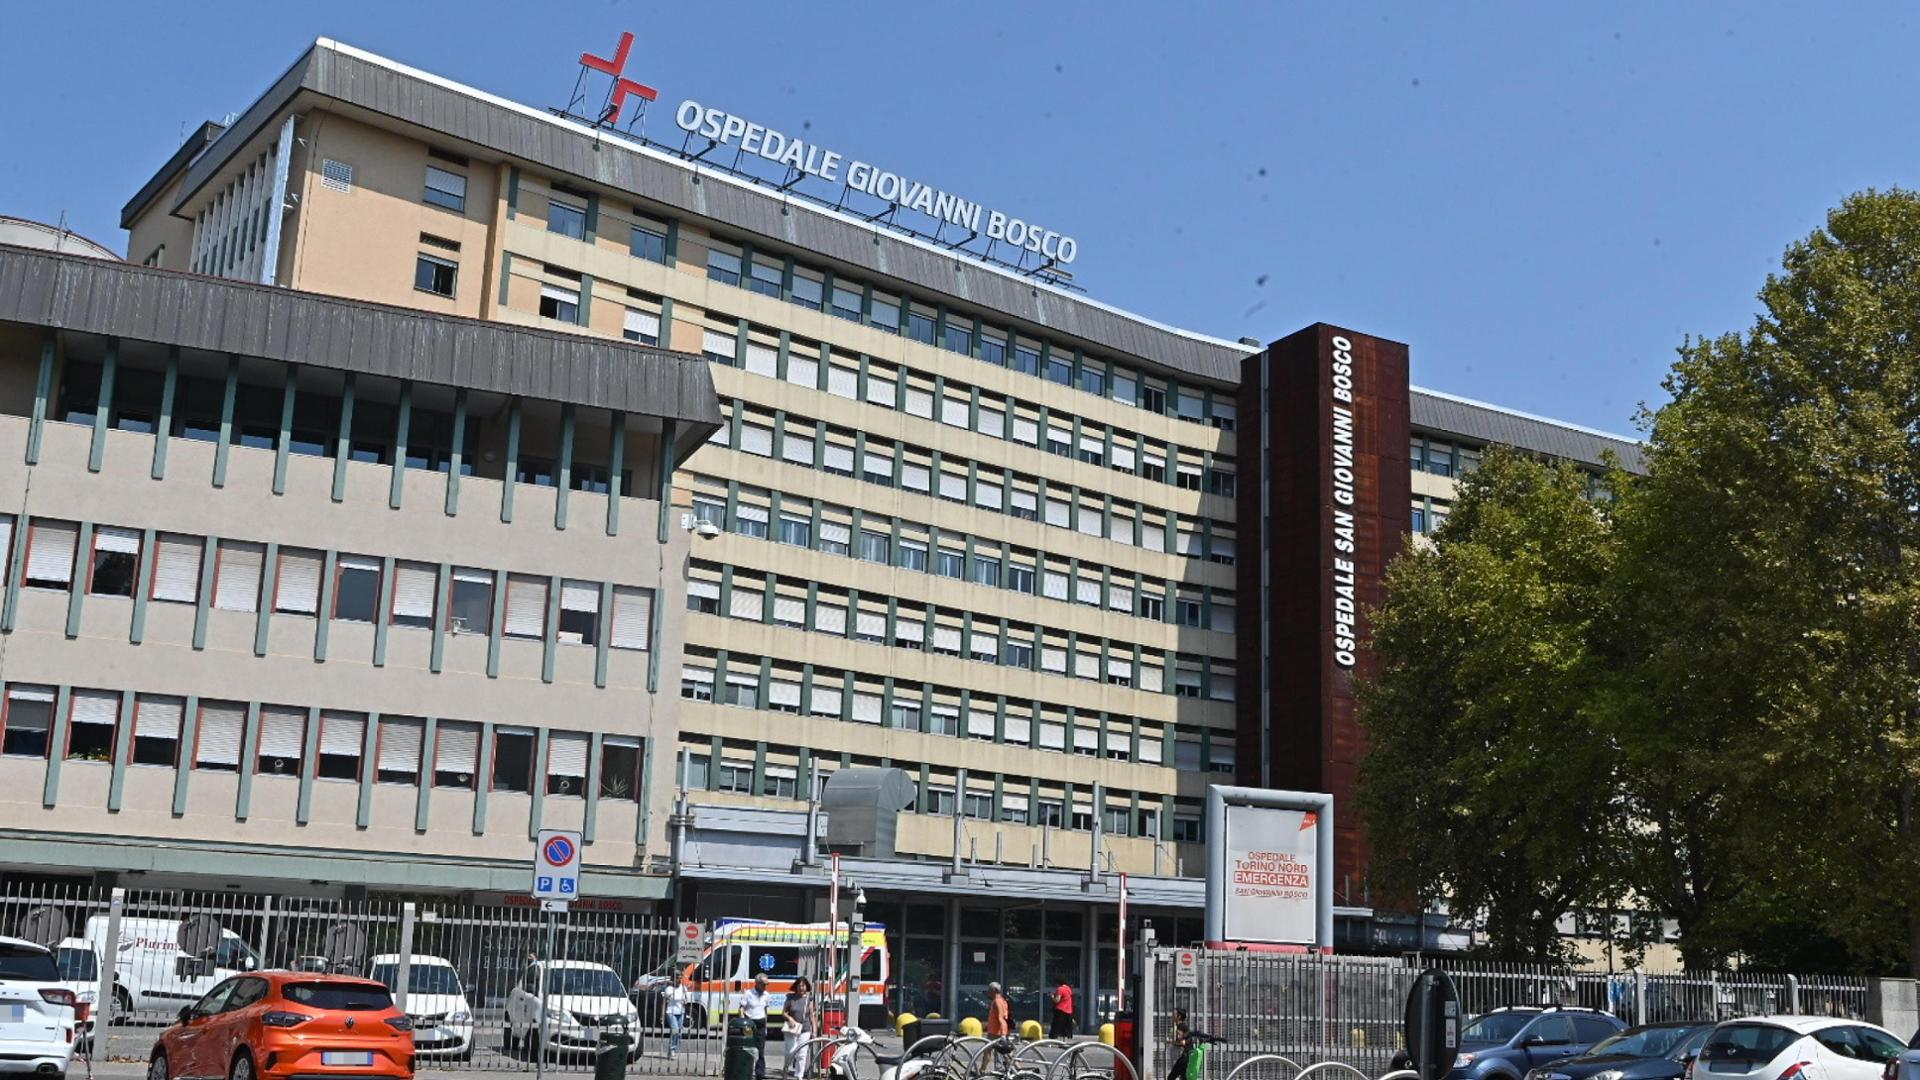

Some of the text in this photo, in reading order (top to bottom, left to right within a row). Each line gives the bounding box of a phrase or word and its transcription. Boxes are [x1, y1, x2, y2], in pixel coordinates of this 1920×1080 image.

[676, 100, 1078, 264] OSPEDALE GIOVANNI BOSCO
[1332, 335, 1356, 667] OSPEDALE SAN GIOVANNI BOSCO
[1247, 851, 1296, 863] OSPEDALE
[1277, 861, 1308, 873] NORD
[1234, 872, 1308, 887] EMERGENZA
